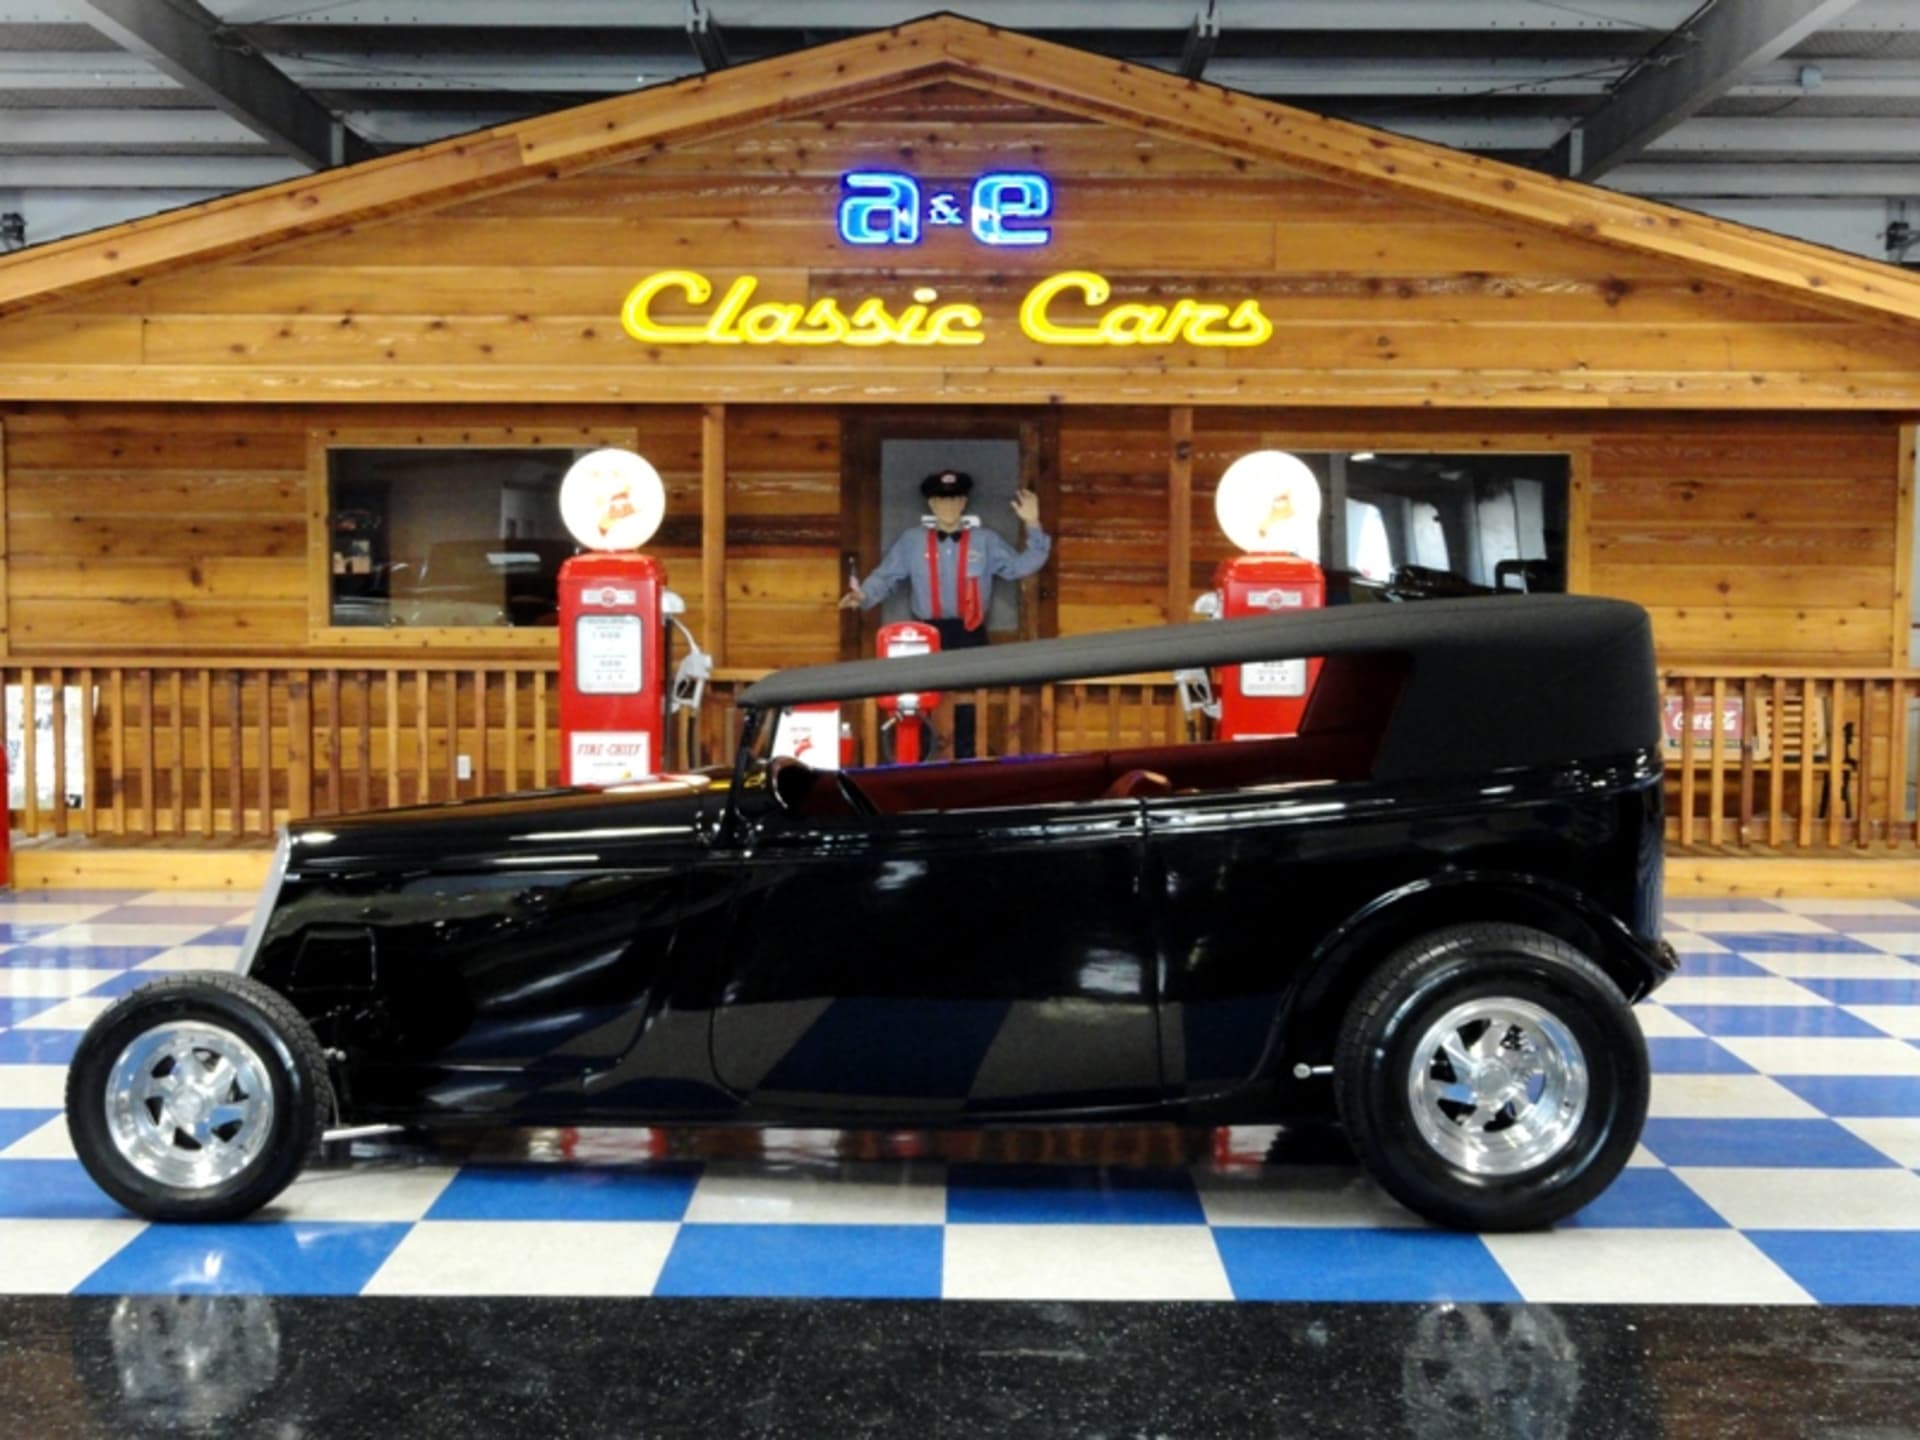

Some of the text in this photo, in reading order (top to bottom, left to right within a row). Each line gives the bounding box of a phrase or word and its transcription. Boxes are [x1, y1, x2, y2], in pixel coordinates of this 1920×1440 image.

[840, 171, 1051, 246] a & e
[620, 270, 1273, 346] Classic Cars
